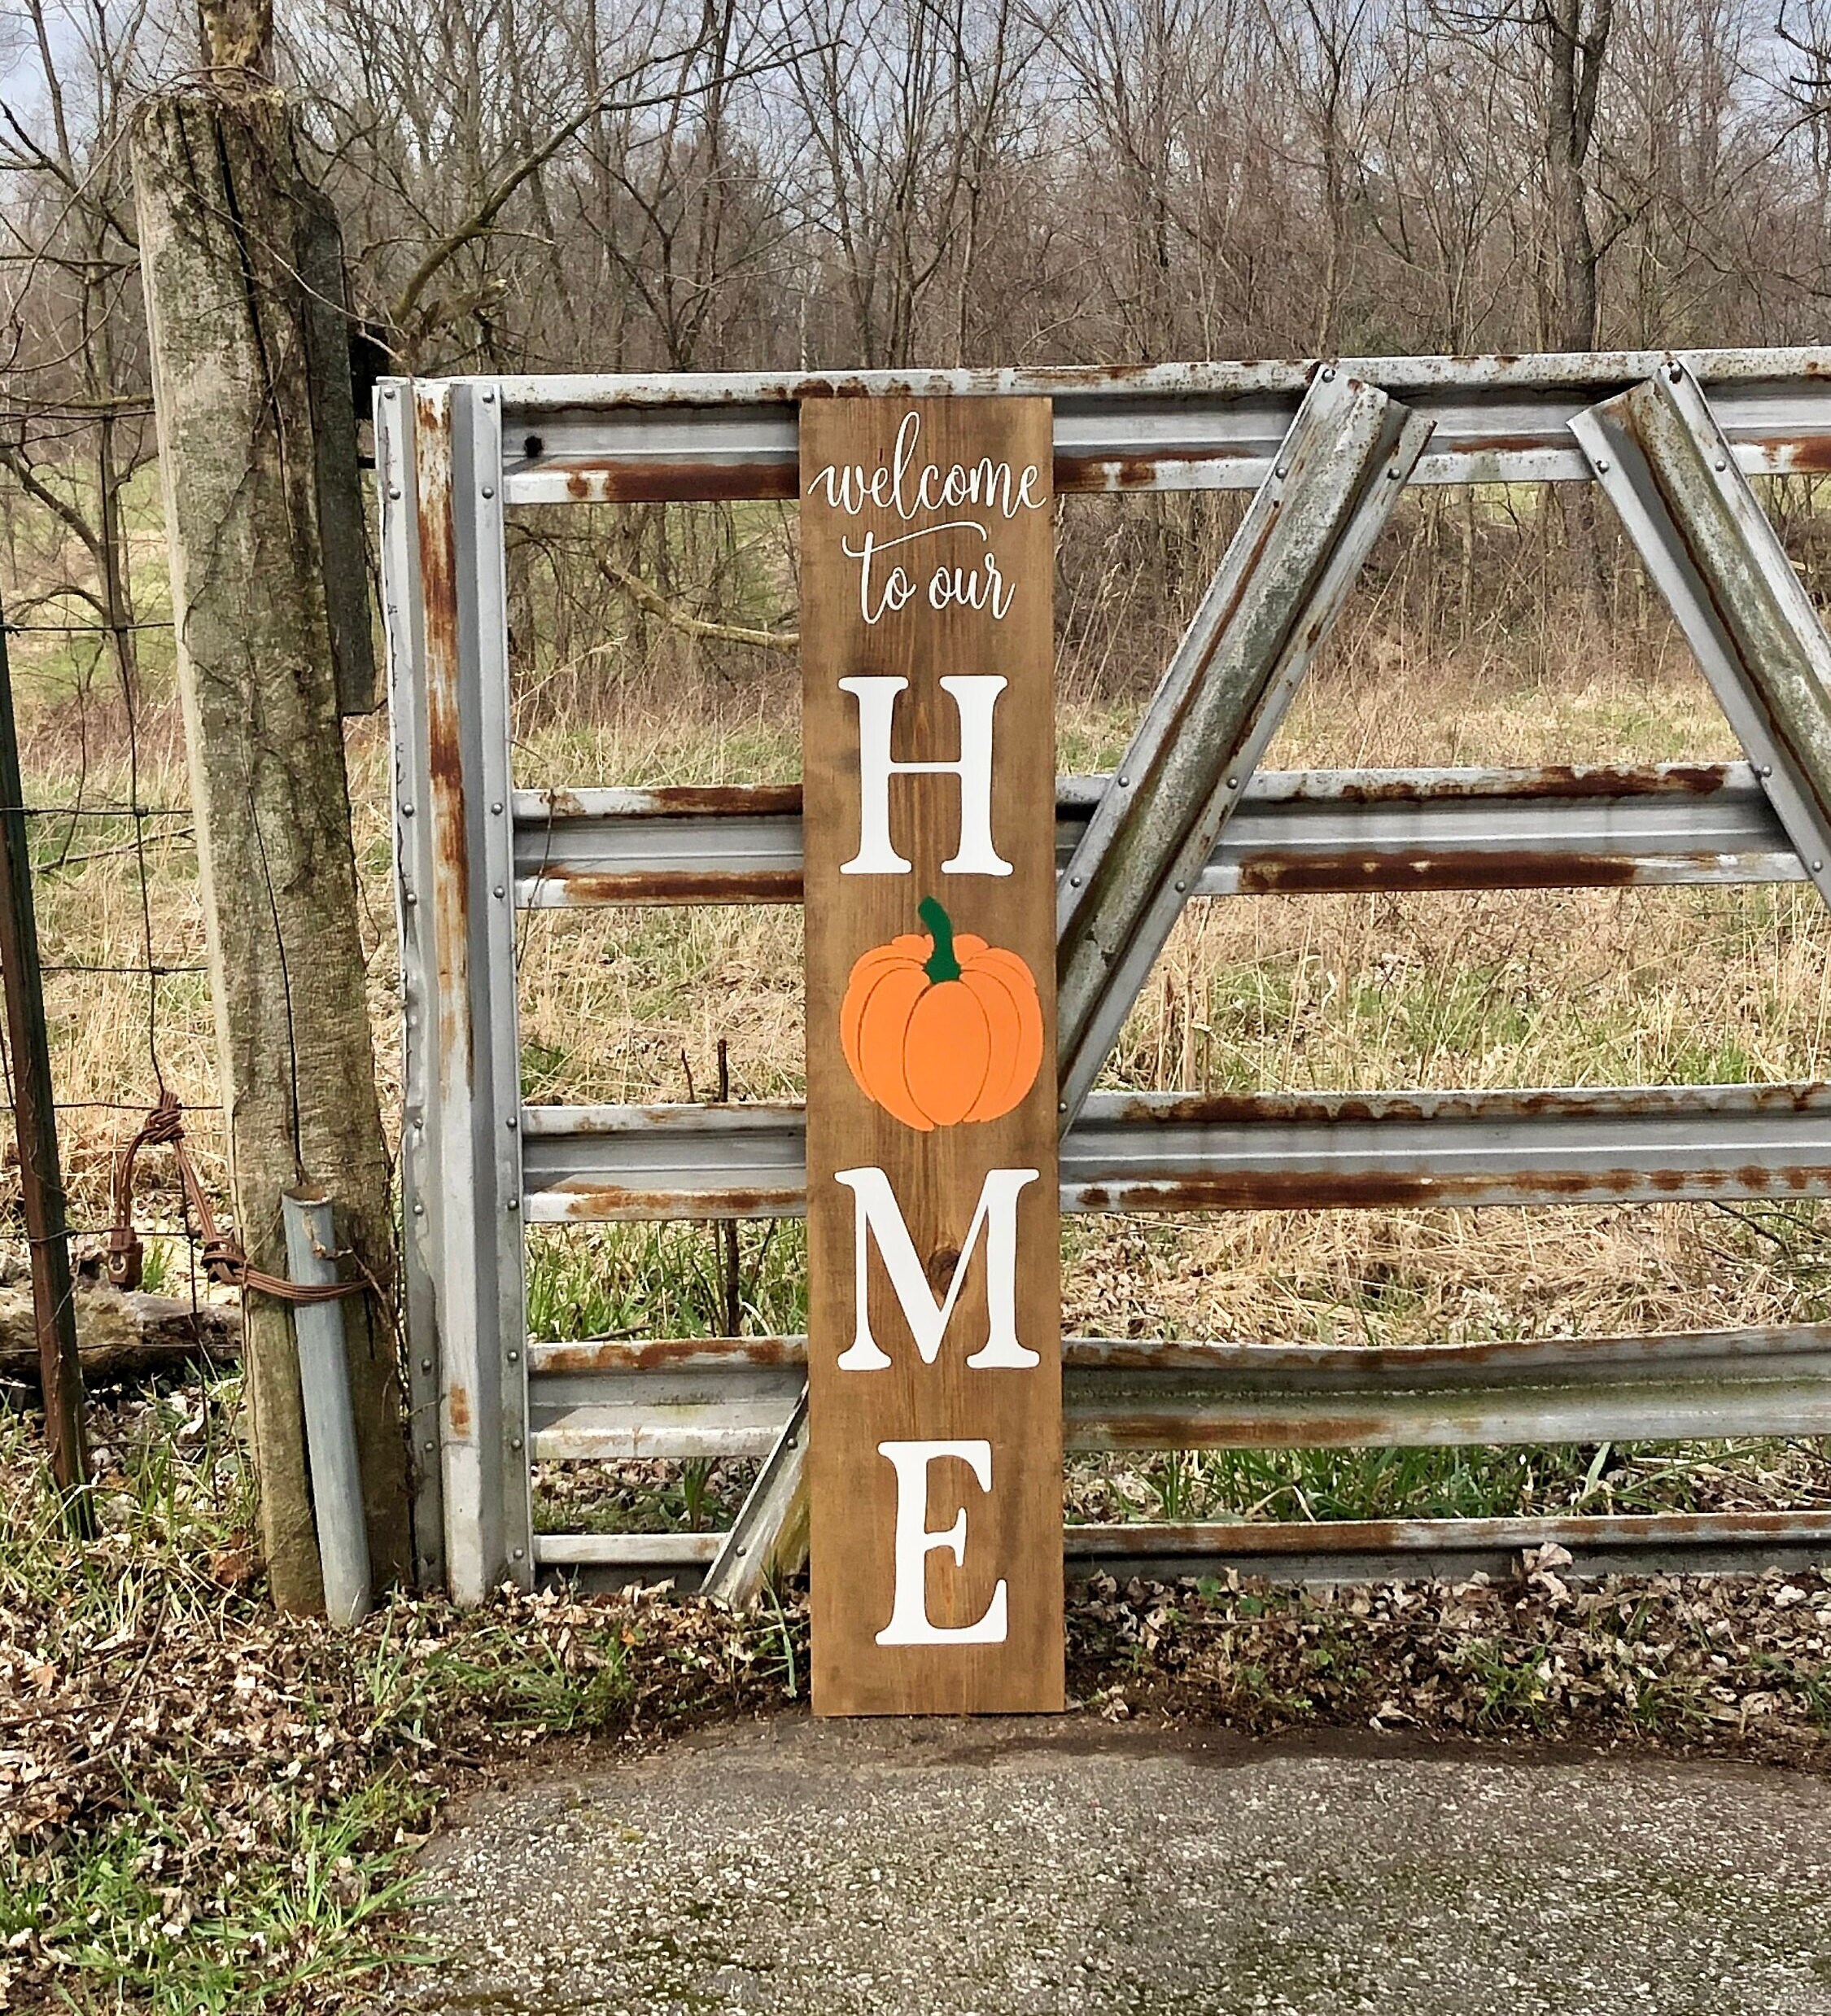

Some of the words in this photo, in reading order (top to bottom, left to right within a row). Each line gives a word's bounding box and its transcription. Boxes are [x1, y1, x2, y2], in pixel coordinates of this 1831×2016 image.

[807, 411, 1047, 520] welcome
[841, 521, 988, 624] to
[929, 553, 1016, 619] our
